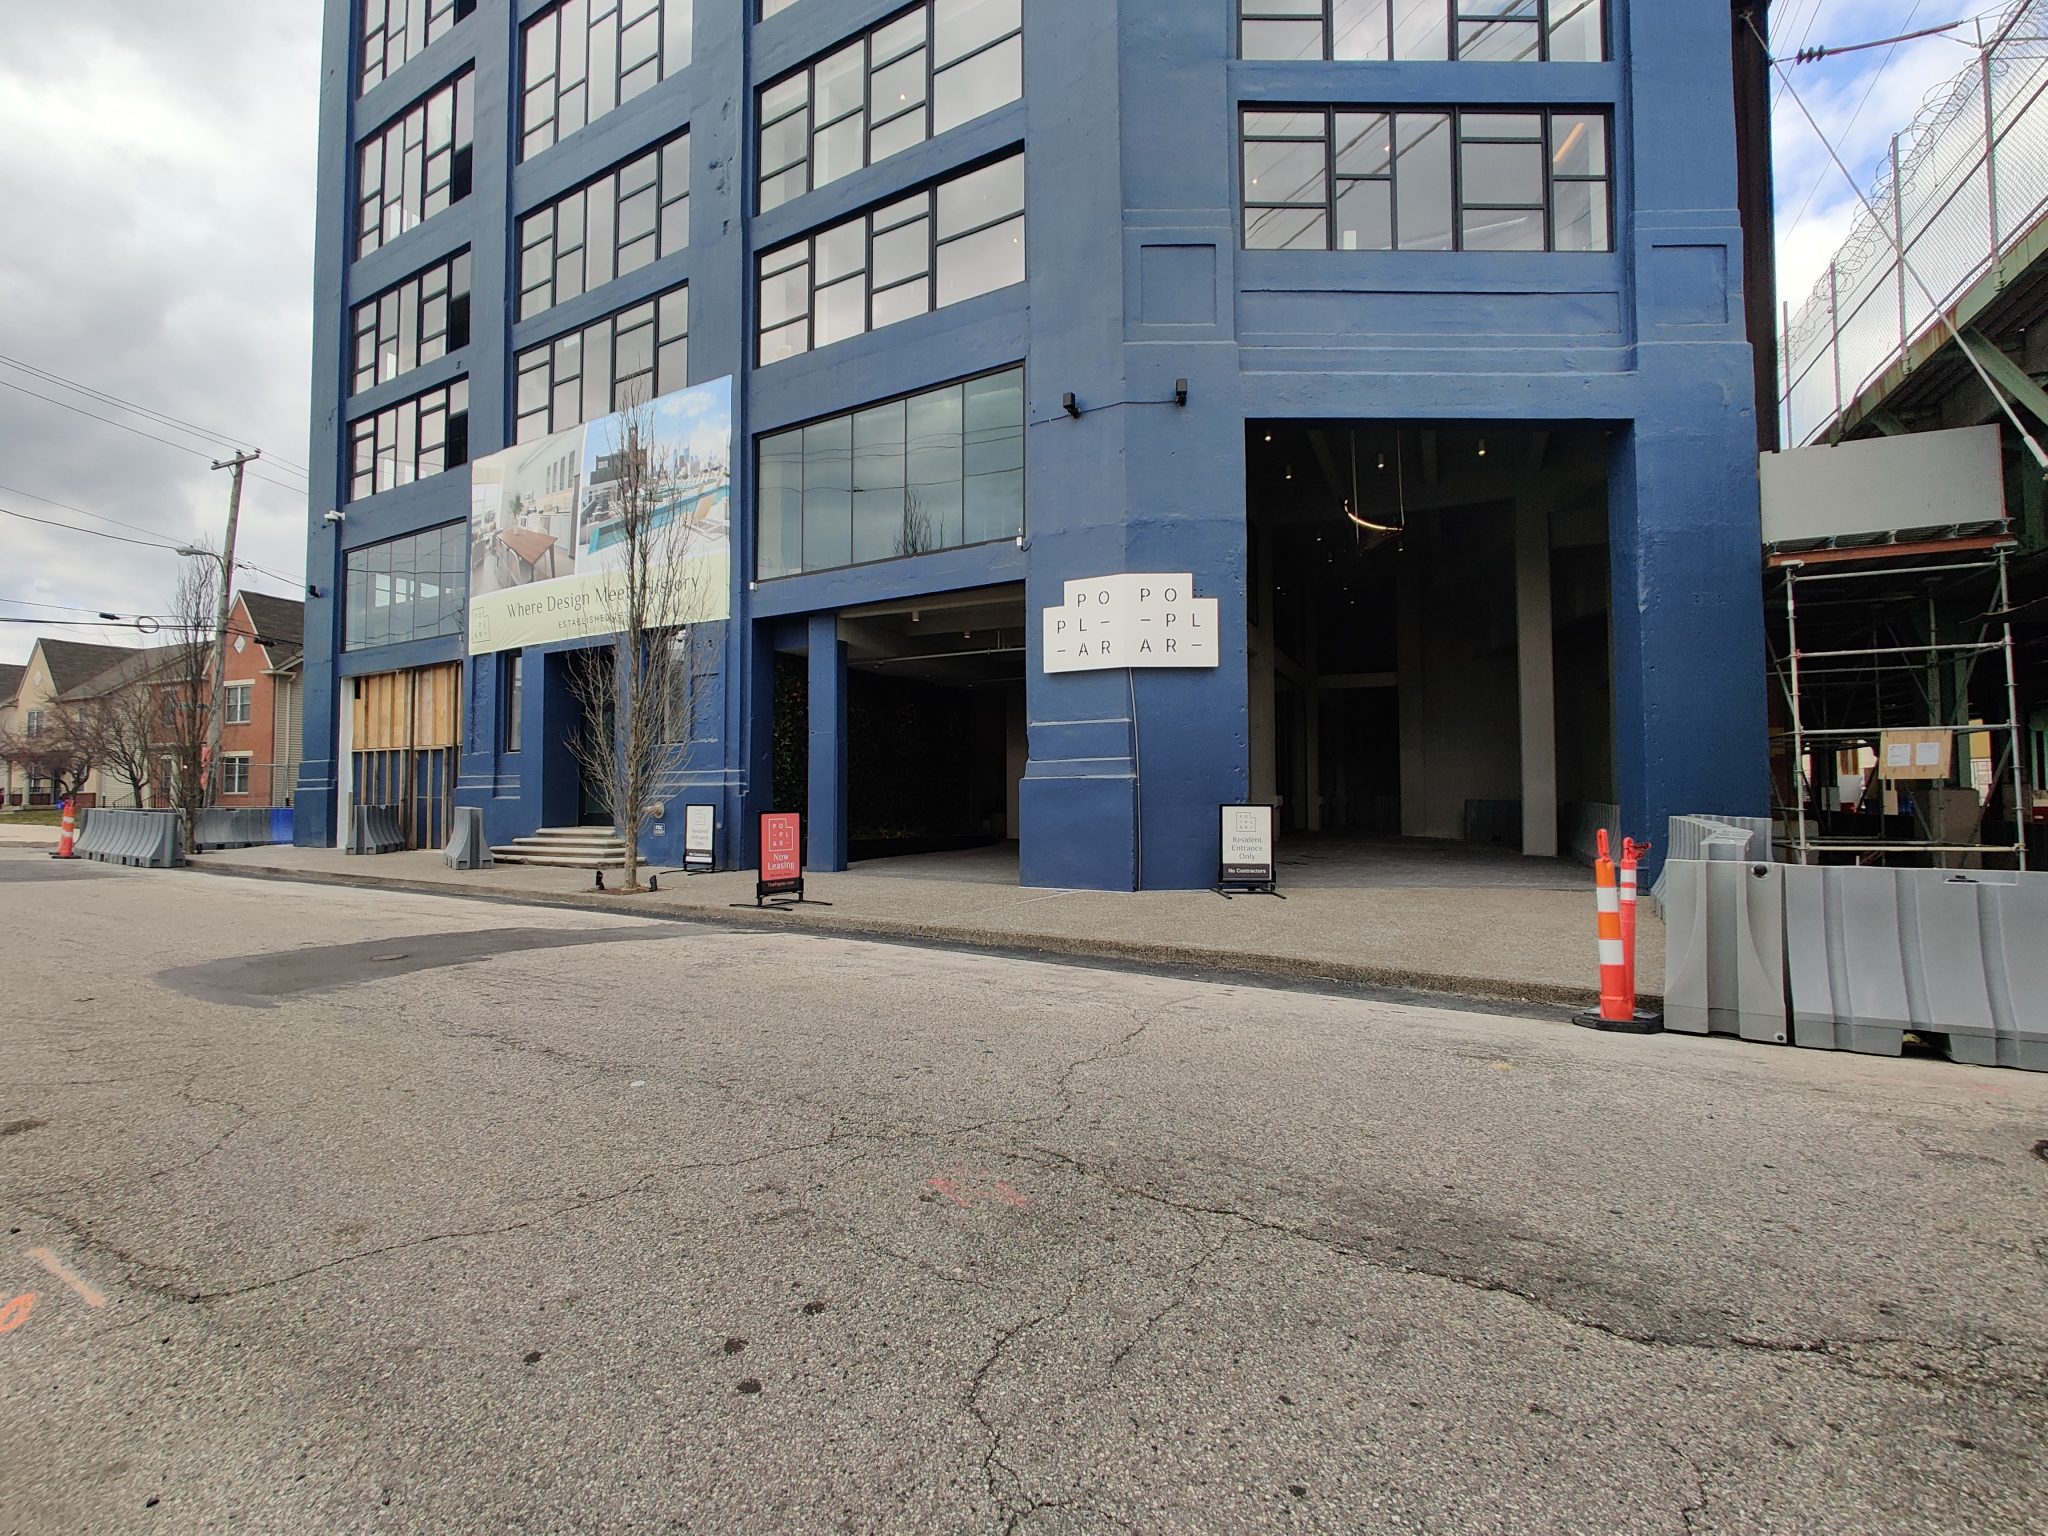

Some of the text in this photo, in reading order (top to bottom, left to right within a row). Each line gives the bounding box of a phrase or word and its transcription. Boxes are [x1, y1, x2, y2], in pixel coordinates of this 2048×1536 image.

[1077, 590, 1110, 608] PO
[1140, 587, 1177, 602] PO
[507, 602, 543, 618] Where
[547, 593, 590, 611] Design
[558, 612, 609, 628] ESTABLISHED
[773, 853, 789, 861] Now
[1239, 853, 1255, 861] Only
[767, 861, 795, 870] Leasing
